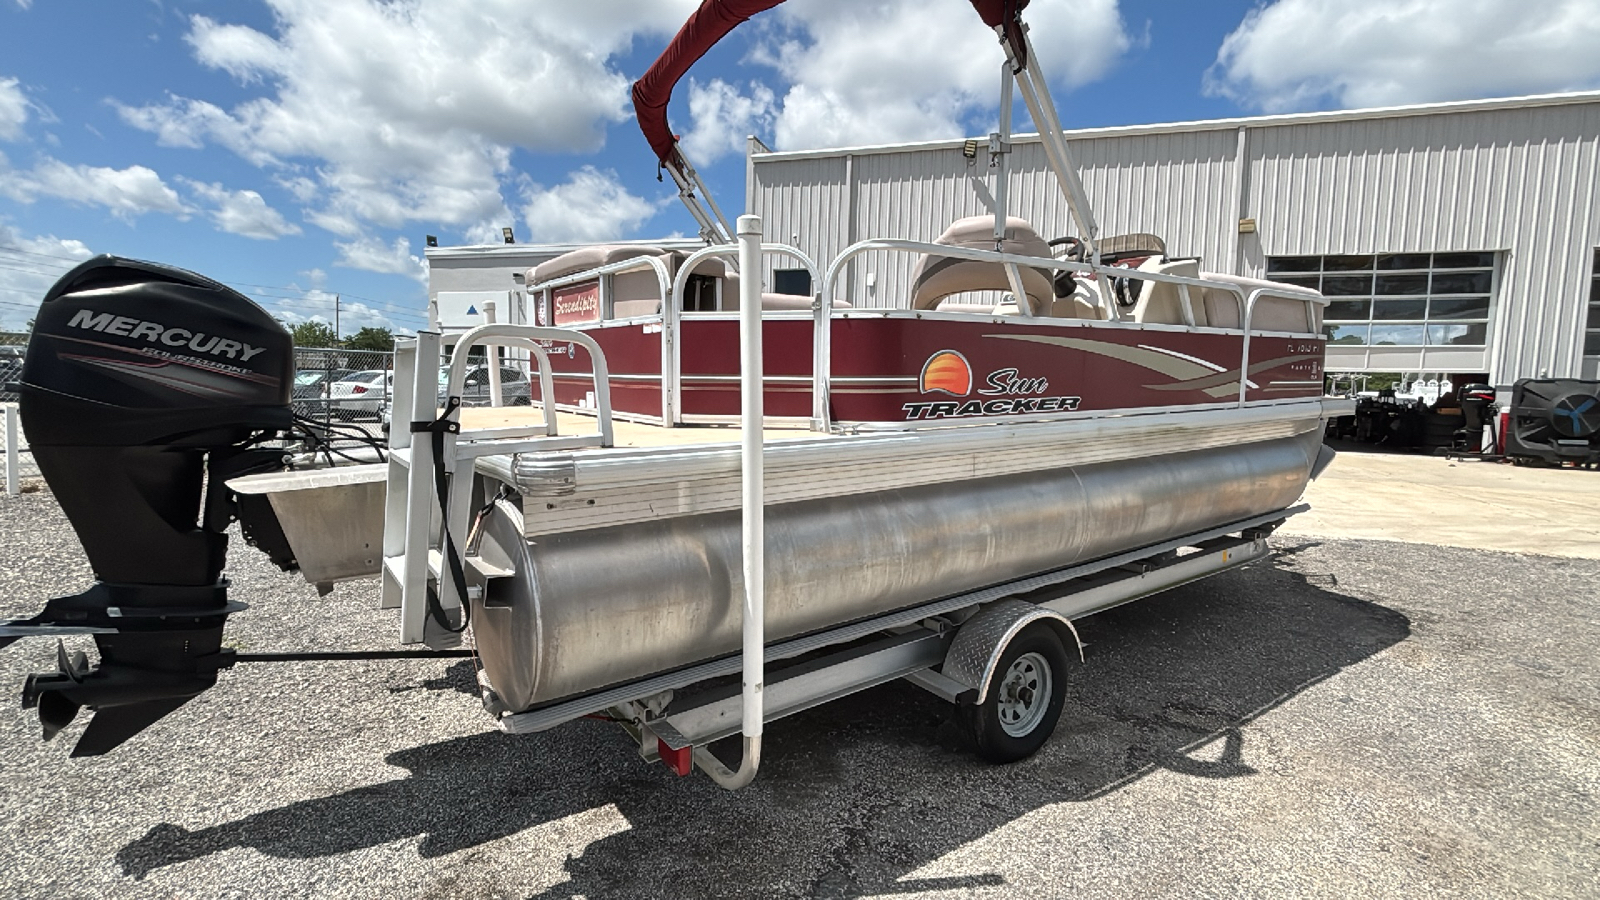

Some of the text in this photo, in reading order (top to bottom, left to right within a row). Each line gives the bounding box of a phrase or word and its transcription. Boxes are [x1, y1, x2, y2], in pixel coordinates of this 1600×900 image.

[555, 294, 597, 316] Serendipity
[67, 309, 267, 362] MERCURY
[141, 346, 253, 375] FOURSTROKE
[977, 367, 1048, 396] Sun
[902, 396, 1081, 420] TRACKER
